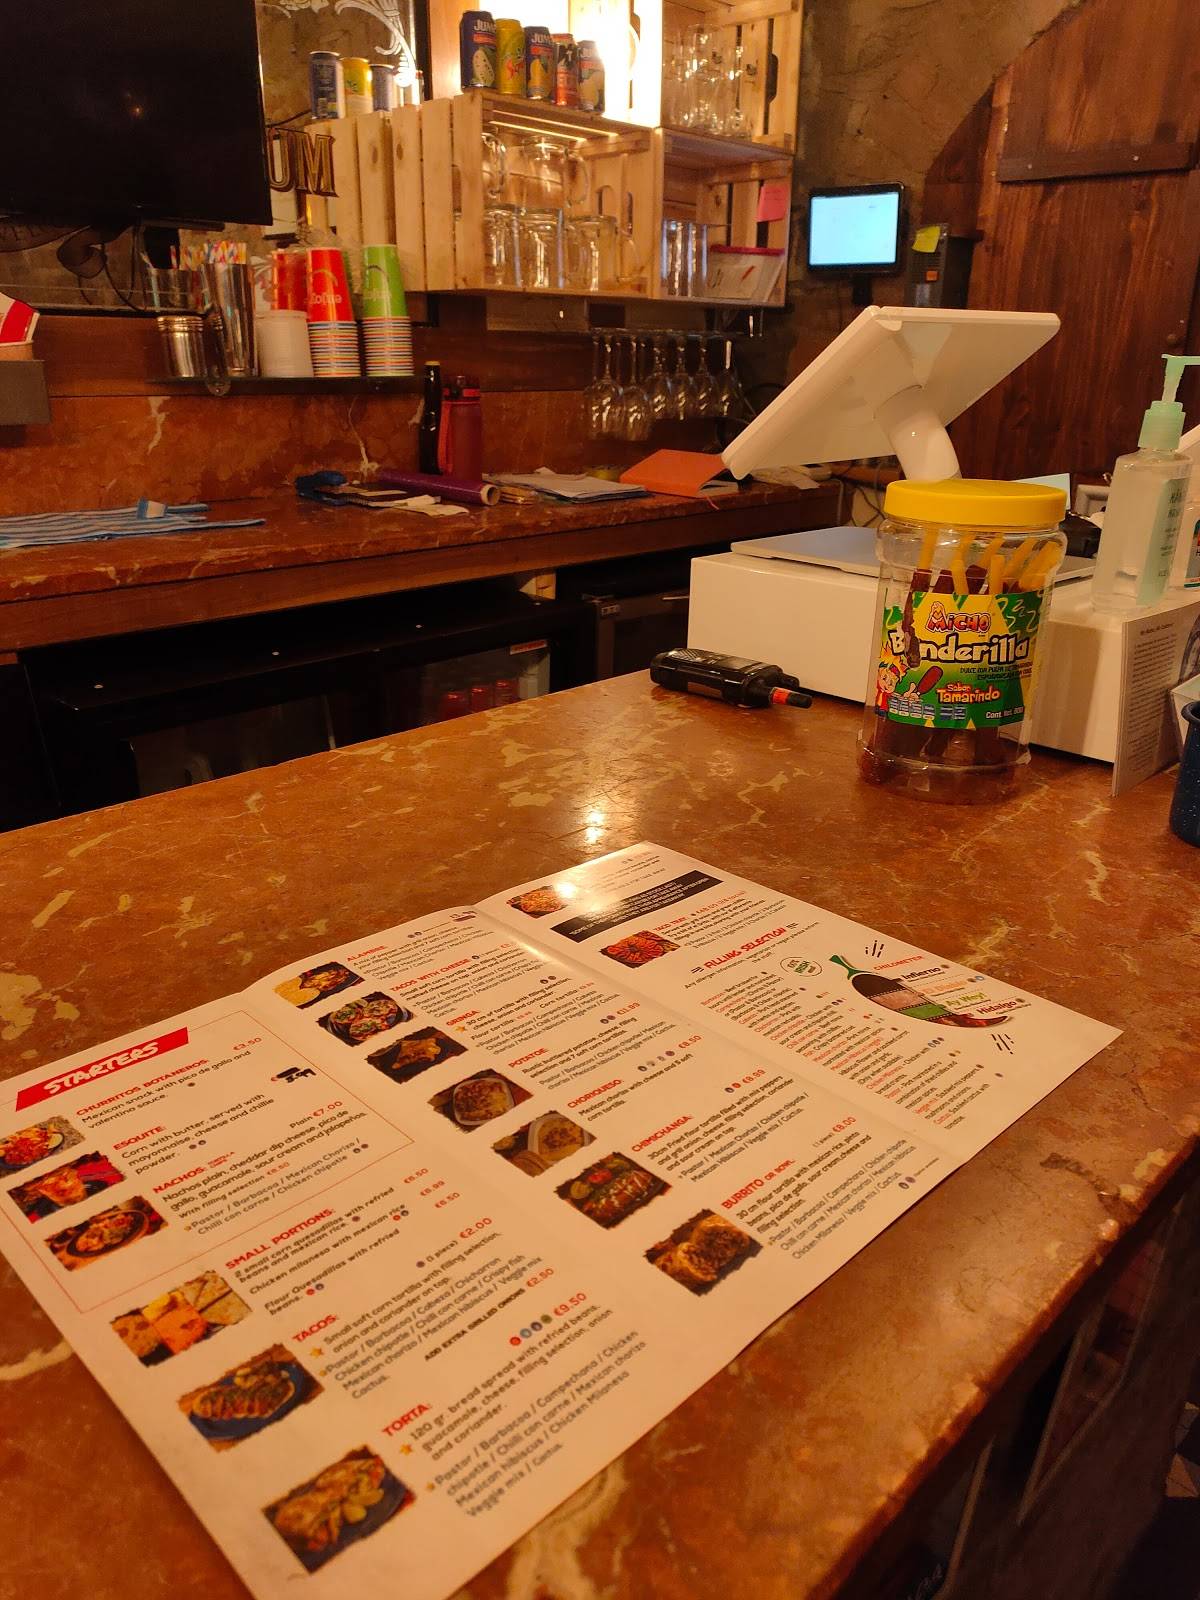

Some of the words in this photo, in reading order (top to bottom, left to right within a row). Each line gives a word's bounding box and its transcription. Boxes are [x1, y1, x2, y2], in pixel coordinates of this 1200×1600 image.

[888, 630, 1030, 664] Bnderilla
[936, 685, 1001, 704] Tamarindo
[703, 950, 743, 969] FILLING
[740, 927, 787, 952] SELECTION
[900, 967, 942, 980] Infierno
[976, 1000, 1017, 1015] Hidalgo
[43, 1041, 159, 1094] STARTERS
[312, 1101, 343, 1117] €7.00
[459, 1217, 492, 1239] €2.00
[553, 1292, 587, 1317] €9.50
